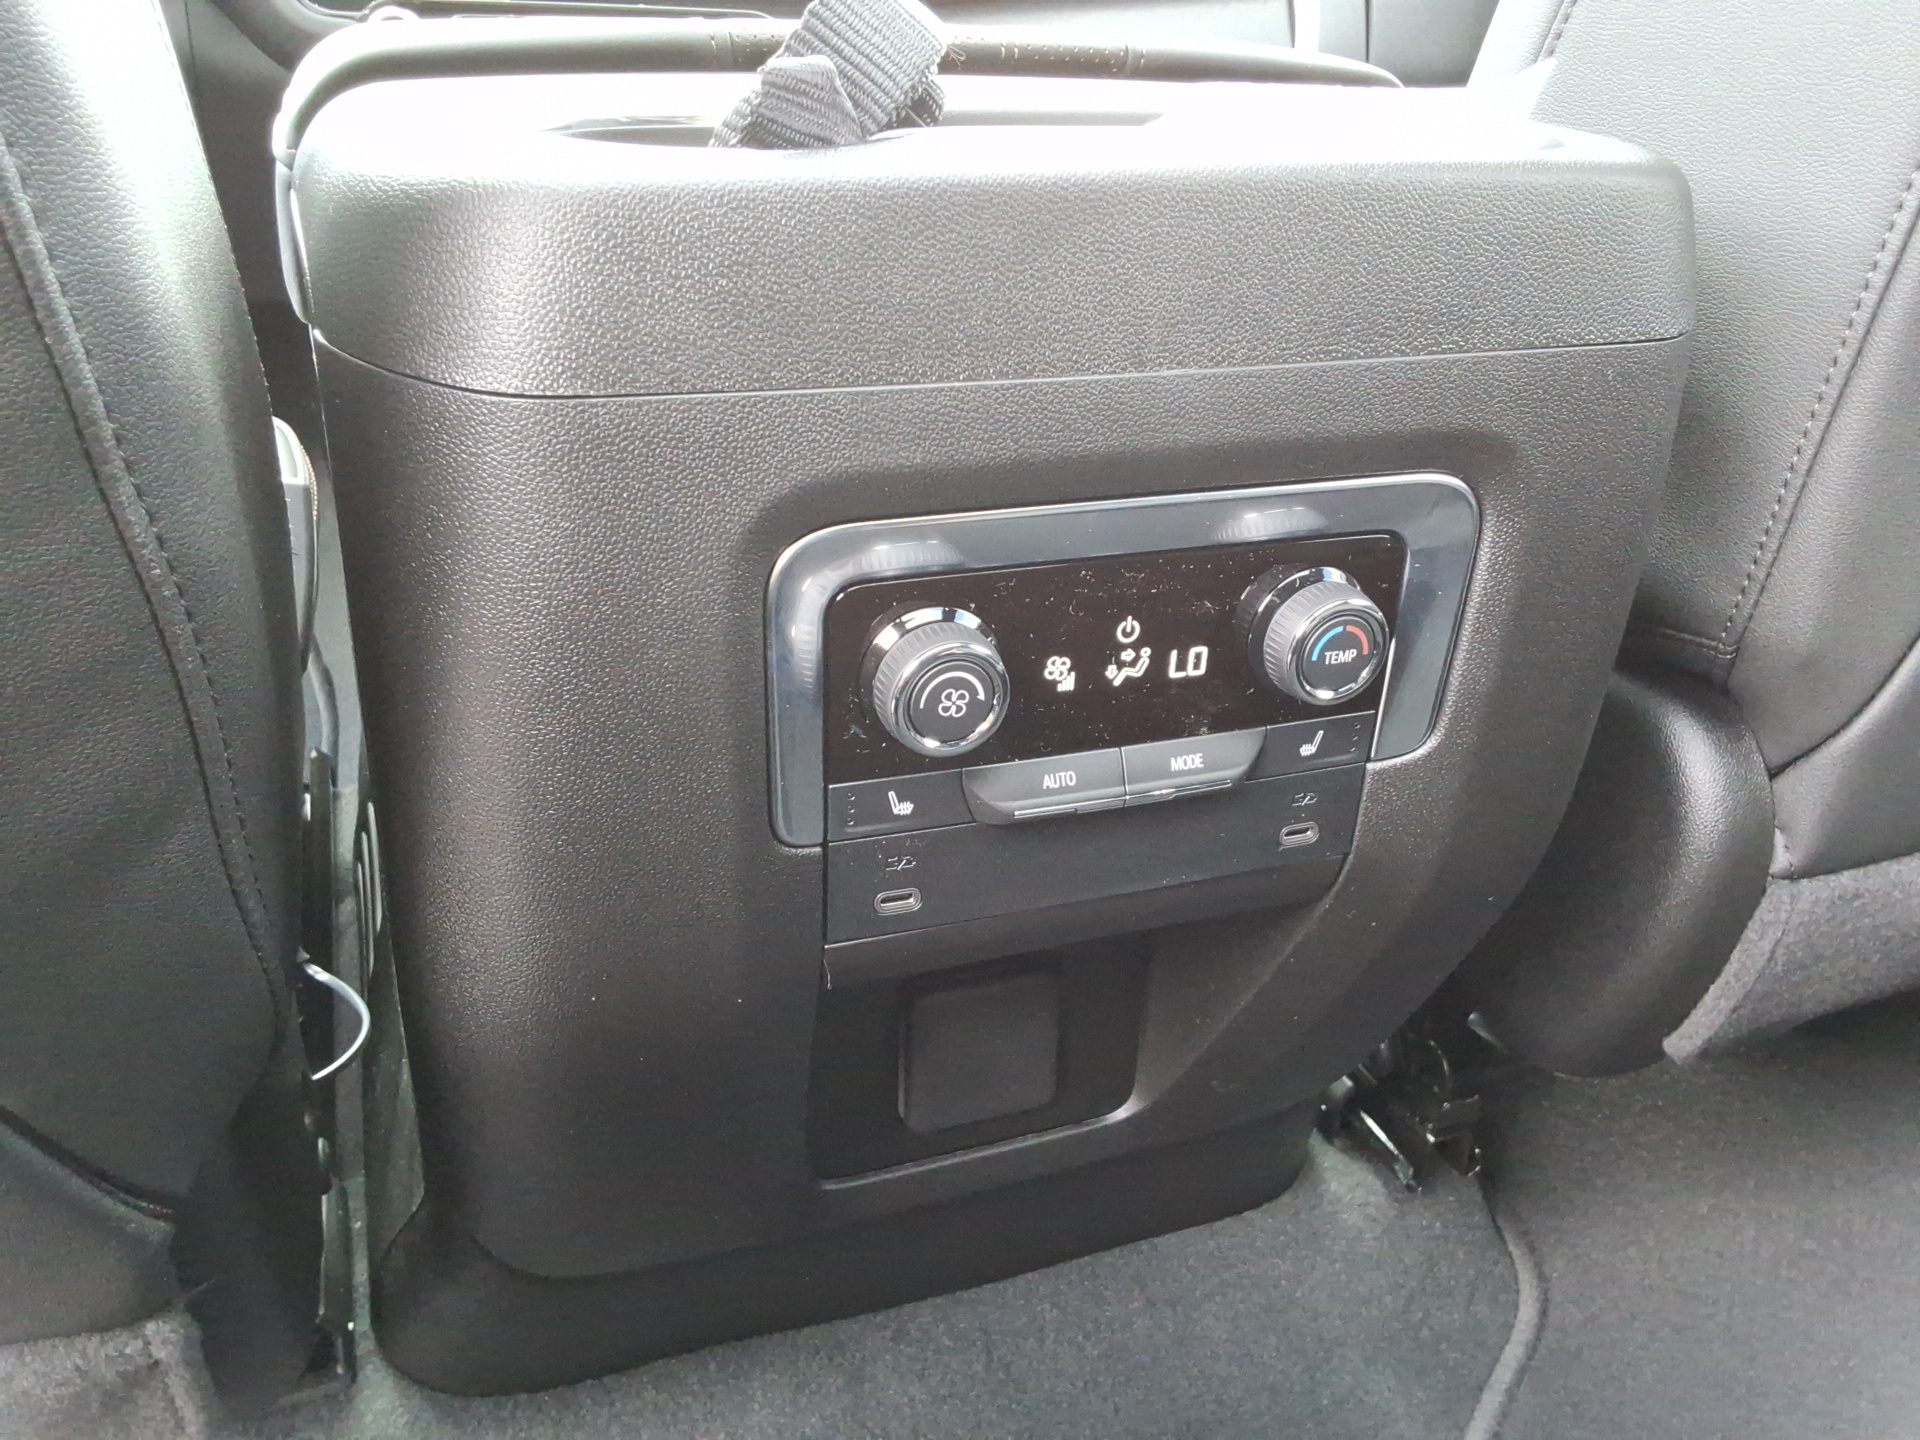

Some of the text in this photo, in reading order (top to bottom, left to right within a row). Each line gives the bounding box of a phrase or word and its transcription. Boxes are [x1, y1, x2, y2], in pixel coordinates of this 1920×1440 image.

[1168, 645, 1208, 678] LO
[1324, 649, 1357, 665] TEMP
[1170, 753, 1204, 772] MODE
[1043, 771, 1077, 789] AUTO
